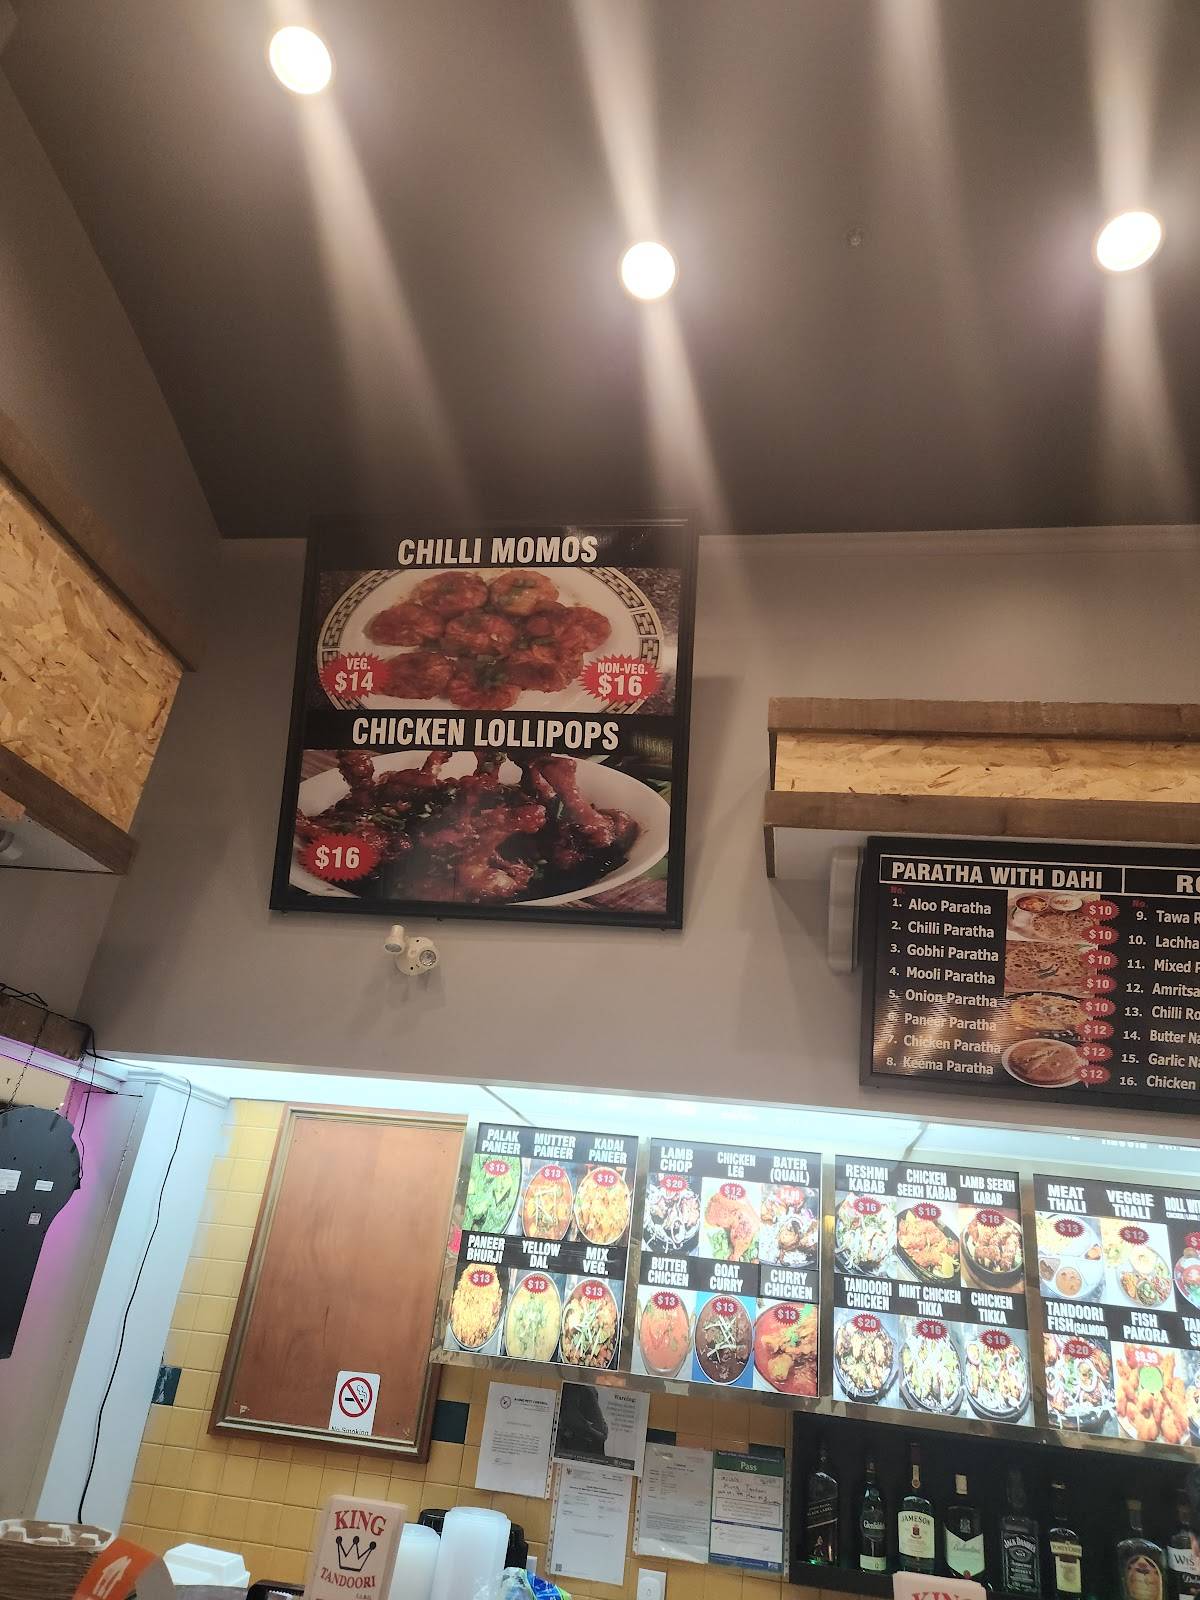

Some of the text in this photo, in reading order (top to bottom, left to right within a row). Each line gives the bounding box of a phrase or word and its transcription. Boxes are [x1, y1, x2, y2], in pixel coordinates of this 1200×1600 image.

[398, 535, 599, 566] CHILLI MOMOS
[346, 657, 371, 671] VEG.
[597, 661, 648, 675] NON-VEG.
[334, 669, 374, 693] $14
[597, 673, 642, 697] $16
[352, 717, 620, 750] CHICKEN LOLLIPOPS
[315, 845, 360, 870] $16
[892, 861, 1102, 891] PARATHA WITH DAHI
[1177, 874, 1200, 893] R
[892, 898, 992, 914] 1. Aloo Paratha
[1089, 905, 1112, 915] $10
[1136, 911, 1148, 920] 9.
[1156, 910, 1190, 924] Tawa
[891, 921, 994, 938] 2. Chilli Paratha
[1089, 929, 1112, 940] $10
[1128, 935, 1200, 950] 10. Lachha
[890, 944, 999, 962] 3. Gobhi Paratha
[1088, 954, 1111, 965] $10
[1128, 960, 1145, 969] 11.
[1154, 959, 1192, 973] Mixed
[889, 966, 996, 984] 4. Mooli Paratha
[1086, 978, 1110, 988] $10
[1126, 983, 1144, 994] 12.
[905, 989, 942, 1002] Onion
[947, 992, 998, 1008] Paratha
[1086, 1002, 1108, 1012] $10
[1124, 1006, 1142, 1016] 13.
[1152, 1006, 1182, 1020] Chilli
[950, 1016, 997, 1032] Paratha
[1084, 1024, 1107, 1035] $12
[904, 1035, 951, 1050] Chicken
[954, 1039, 1001, 1054] Paratha
[1123, 1030, 1140, 1040] 14.
[1150, 1030, 1186, 1044] Butter
[1083, 1046, 1106, 1057] $12
[886, 1058, 896, 1066] 8.
[946, 1060, 994, 1075] Paratha
[1122, 1054, 1139, 1064] 15.
[1148, 1053, 1184, 1068] Garlic
[1081, 1069, 1103, 1079] $12
[1120, 1076, 1196, 1090] 16. Chicken
[487, 1128, 519, 1142] PALAK
[534, 1133, 576, 1148] MUTTER
[482, 1140, 520, 1155] PANEER
[594, 1137, 624, 1151] KADAI
[534, 1145, 574, 1160] PANEER
[588, 1150, 628, 1165] PANEER
[661, 1147, 693, 1162] LAMB
[717, 1152, 756, 1167] CHICKEN
[489, 1163, 506, 1172] $13
[660, 1158, 692, 1172] CHOP
[774, 1156, 808, 1170] BATER
[545, 1168, 561, 1178] $13
[596, 1174, 614, 1184] $13
[728, 1165, 744, 1178] LEG
[770, 1168, 810, 1186] (QUAIL)
[846, 1164, 888, 1181] RESHMI
[906, 1168, 947, 1186] CHICKEN
[849, 1177, 886, 1194] KABAB
[960, 1174, 1015, 1192] LAMB SEEKH
[897, 1184, 957, 1201] SEEKH KABAB
[974, 1190, 1002, 1206] KABAB
[1048, 1184, 1084, 1200] MEAT
[1106, 1190, 1154, 1207] VEGGIE
[857, 1202, 876, 1212] $16
[918, 1207, 936, 1217] $16
[1048, 1198, 1087, 1214] THALI
[1112, 1203, 1150, 1220] THALI
[980, 1214, 1000, 1224] $16
[1058, 1222, 1079, 1234] $13
[1124, 1230, 1144, 1241] $12
[468, 1235, 506, 1251] PANEER
[522, 1240, 561, 1257] YELLOW
[466, 1248, 503, 1264] BHURJI
[530, 1254, 548, 1269] DAL
[586, 1247, 608, 1262] MIX
[582, 1260, 609, 1275] VEG.
[652, 1257, 687, 1272] BUTTER
[714, 1262, 740, 1278] GOAT
[472, 1273, 490, 1283] $13
[528, 1280, 545, 1290] $13
[648, 1270, 688, 1286] CHICKEN
[710, 1276, 744, 1293] CURRY
[770, 1270, 808, 1285] CURRY
[585, 1286, 602, 1296] $13
[764, 1283, 812, 1300] CHICKEN
[844, 1277, 892, 1296] TANDOORI
[898, 1284, 961, 1304] MINT CHICKEN
[658, 1296, 676, 1306] $13
[716, 1302, 734, 1313] $13
[847, 1292, 890, 1310] CHICKEN
[971, 1292, 1013, 1310] CHICKEN
[778, 1310, 796, 1320] $13
[917, 1301, 944, 1317] TIKKA
[978, 1309, 1007, 1324] TIKKA
[1046, 1301, 1104, 1322] TANDOORI
[857, 1317, 877, 1328] $20
[1130, 1312, 1158, 1328] FISH
[922, 1324, 942, 1335] $16
[1123, 1326, 1170, 1344] PAKORA
[986, 1334, 1006, 1346] $16
[1068, 1344, 1088, 1355] $20
[740, 1461, 758, 1472] Pass
[334, 1510, 386, 1536] KING
[902, 1515, 930, 1526] JAMESON
[320, 1566, 376, 1588] TANDOORI
